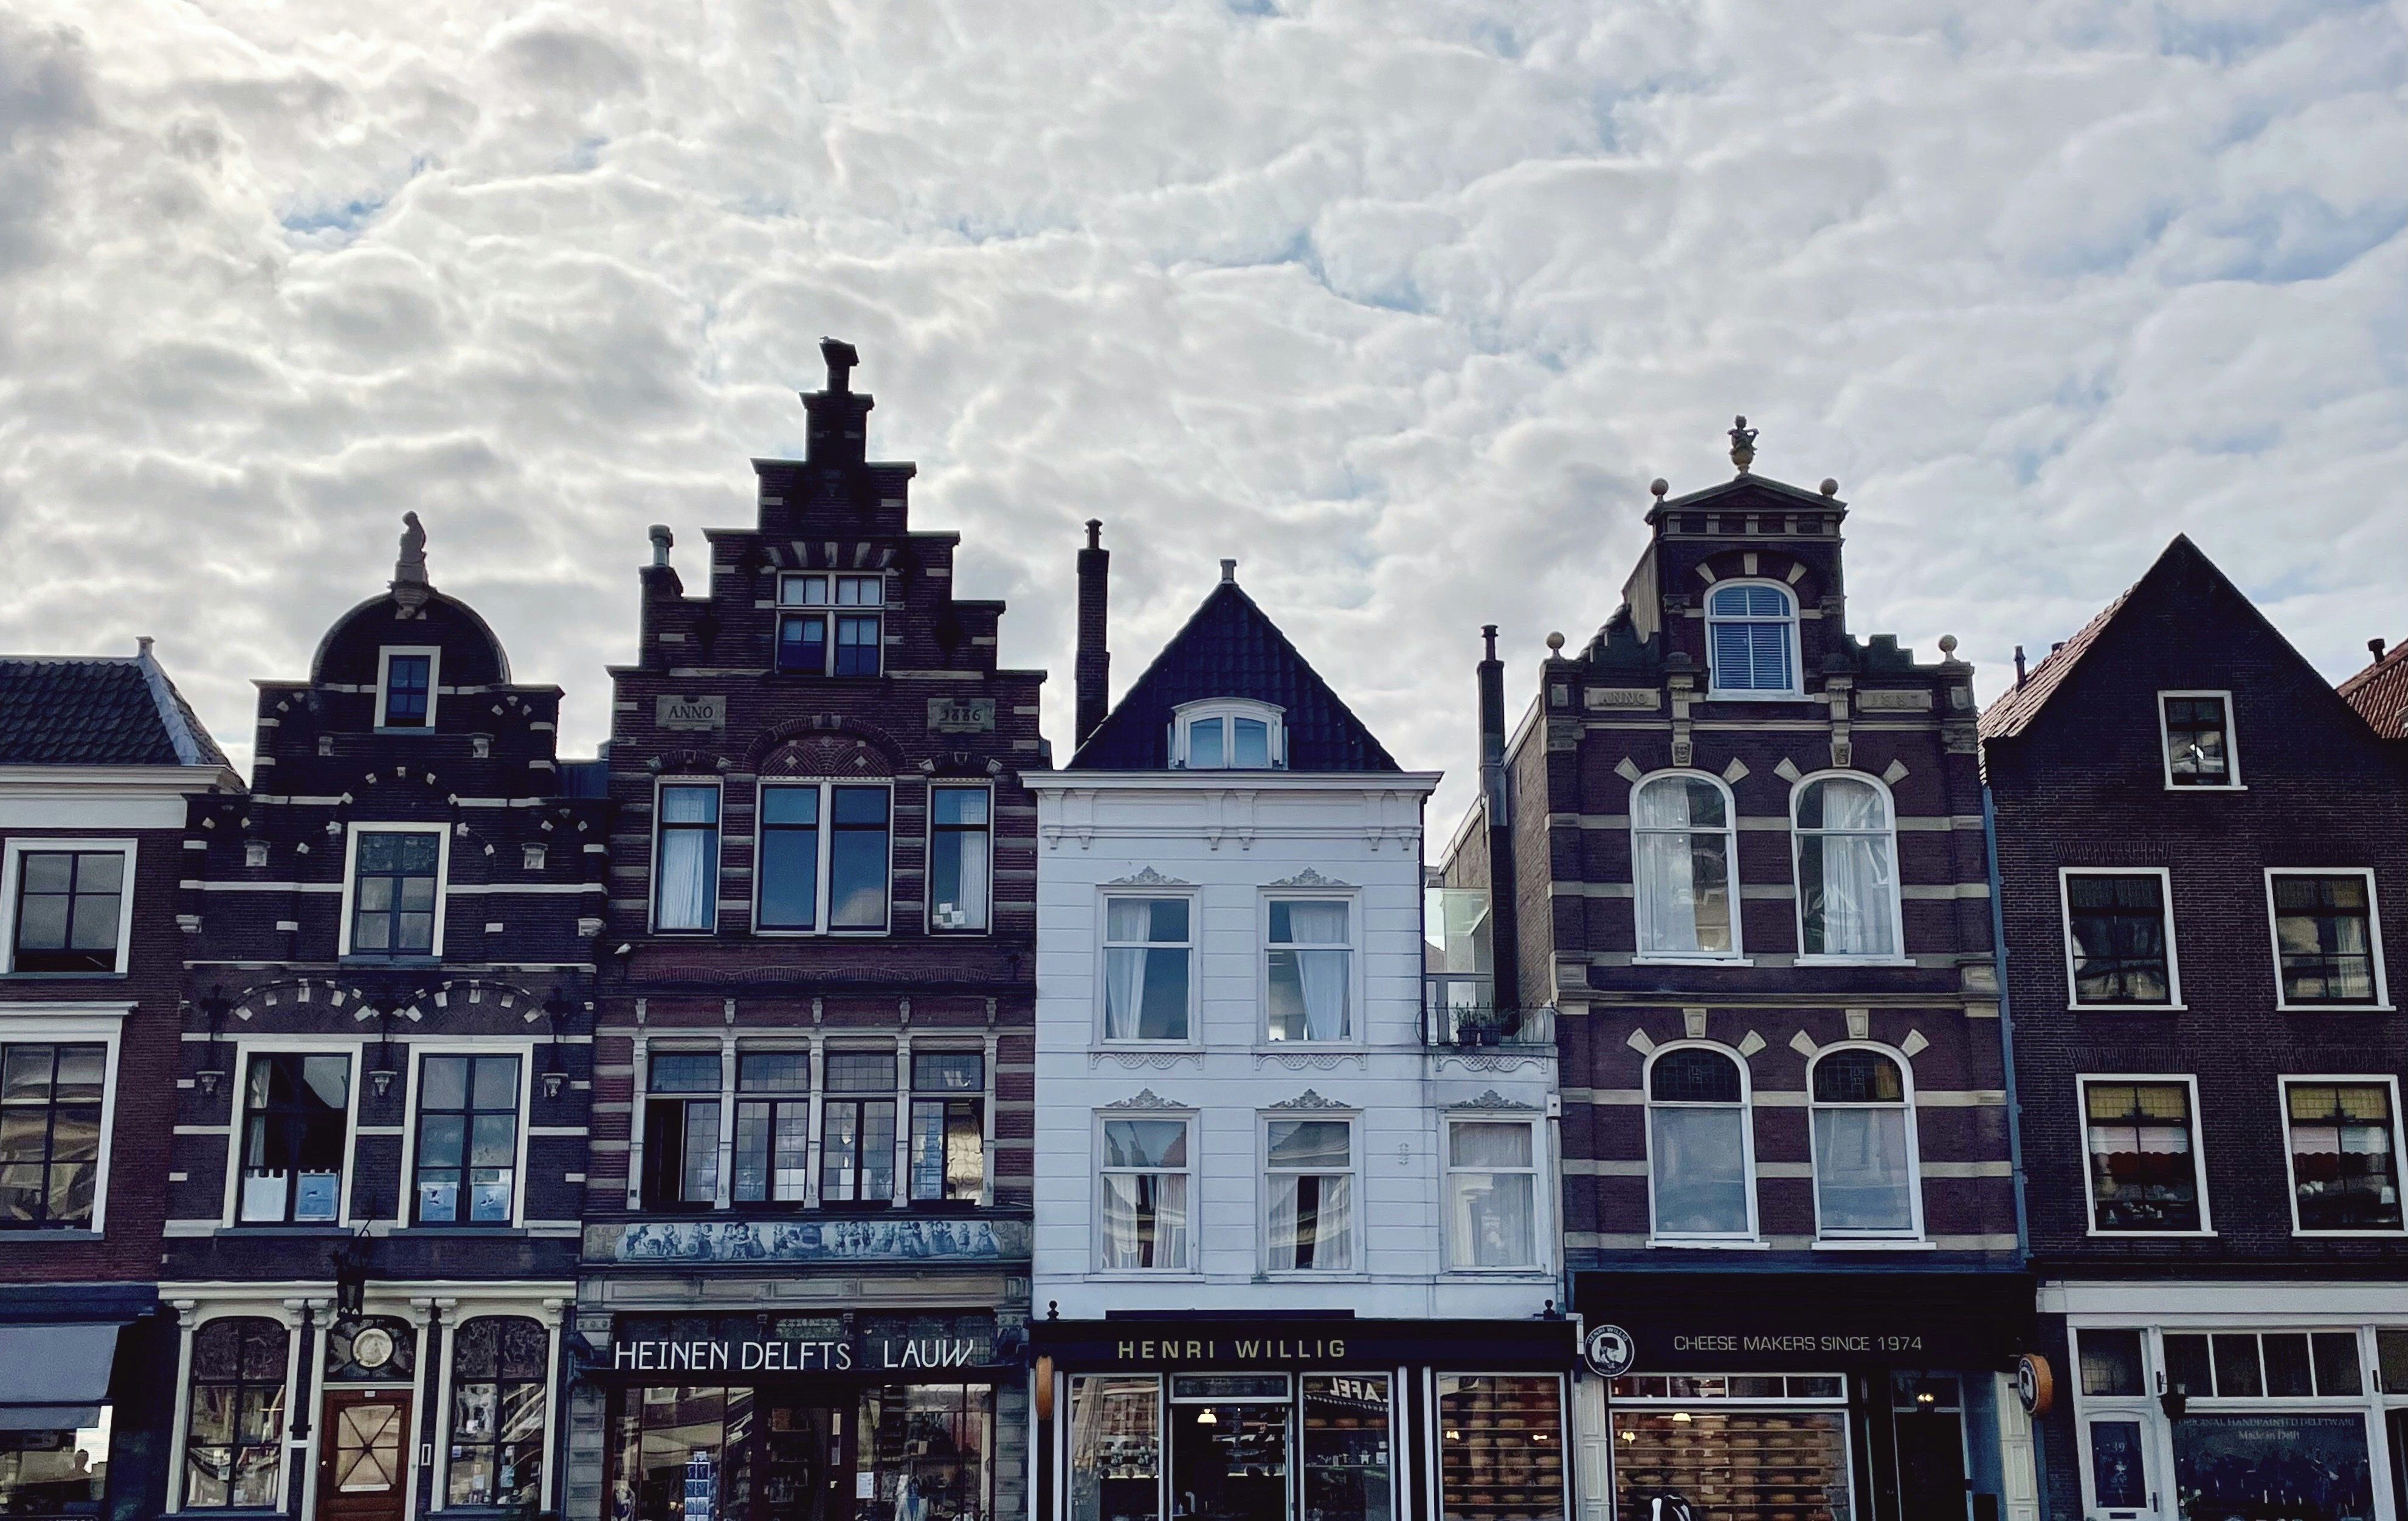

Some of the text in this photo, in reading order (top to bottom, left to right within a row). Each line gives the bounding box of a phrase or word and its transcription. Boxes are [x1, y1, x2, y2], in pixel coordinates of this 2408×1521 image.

[1599, 692, 1647, 705] ANNO
[668, 705, 714, 719] ANNO
[939, 708, 982, 722] 1886
[1588, 1326, 1629, 1344] HENRI WILLIG
[1119, 1339, 1345, 1359] HENRI WILLIG
[1674, 1336, 1922, 1351] CHEESE MAKERS SINCE 1974
[615, 1339, 973, 1370] HEINEN DELFTS LAUW
[2178, 1418, 2226, 1427] ORIGINAL
